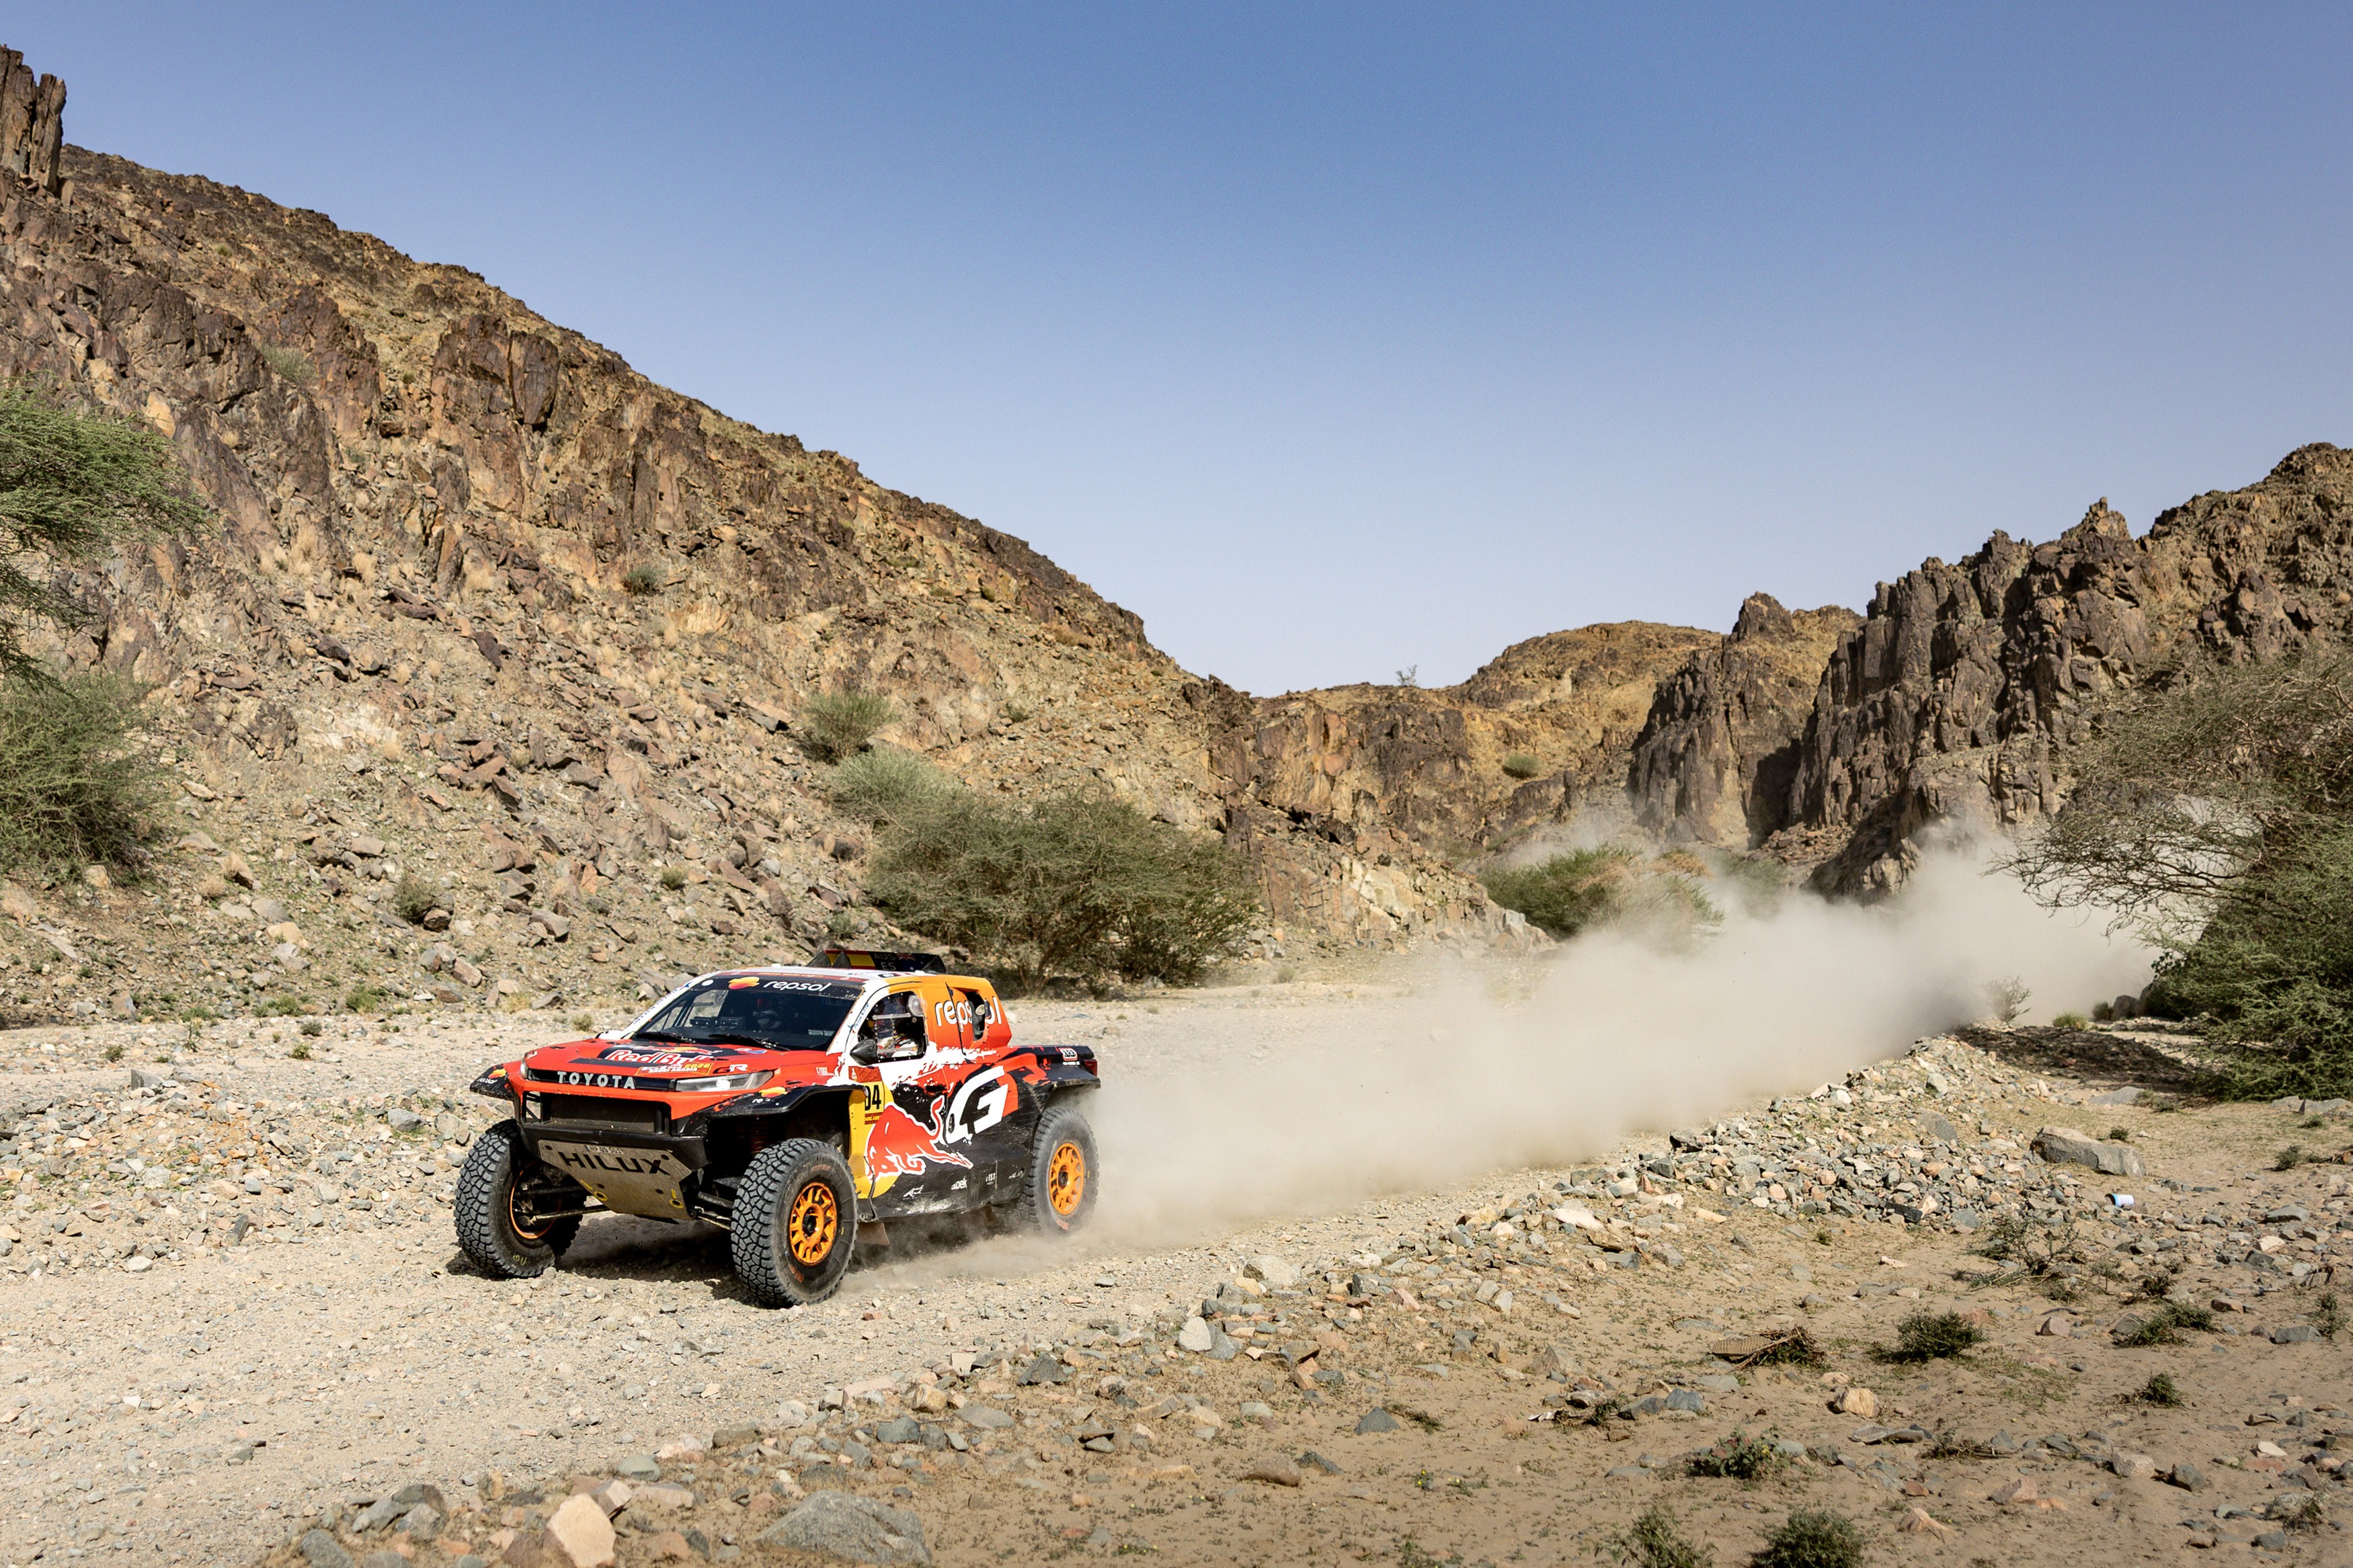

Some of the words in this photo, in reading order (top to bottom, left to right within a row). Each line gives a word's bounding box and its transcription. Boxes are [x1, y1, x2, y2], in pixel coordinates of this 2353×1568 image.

[763, 981, 832, 991] repsol
[604, 1050, 666, 1063] Red
[713, 1063, 748, 1074] GR
[557, 1071, 635, 1089] TOYOTA
[557, 1151, 672, 1176] HILUX
